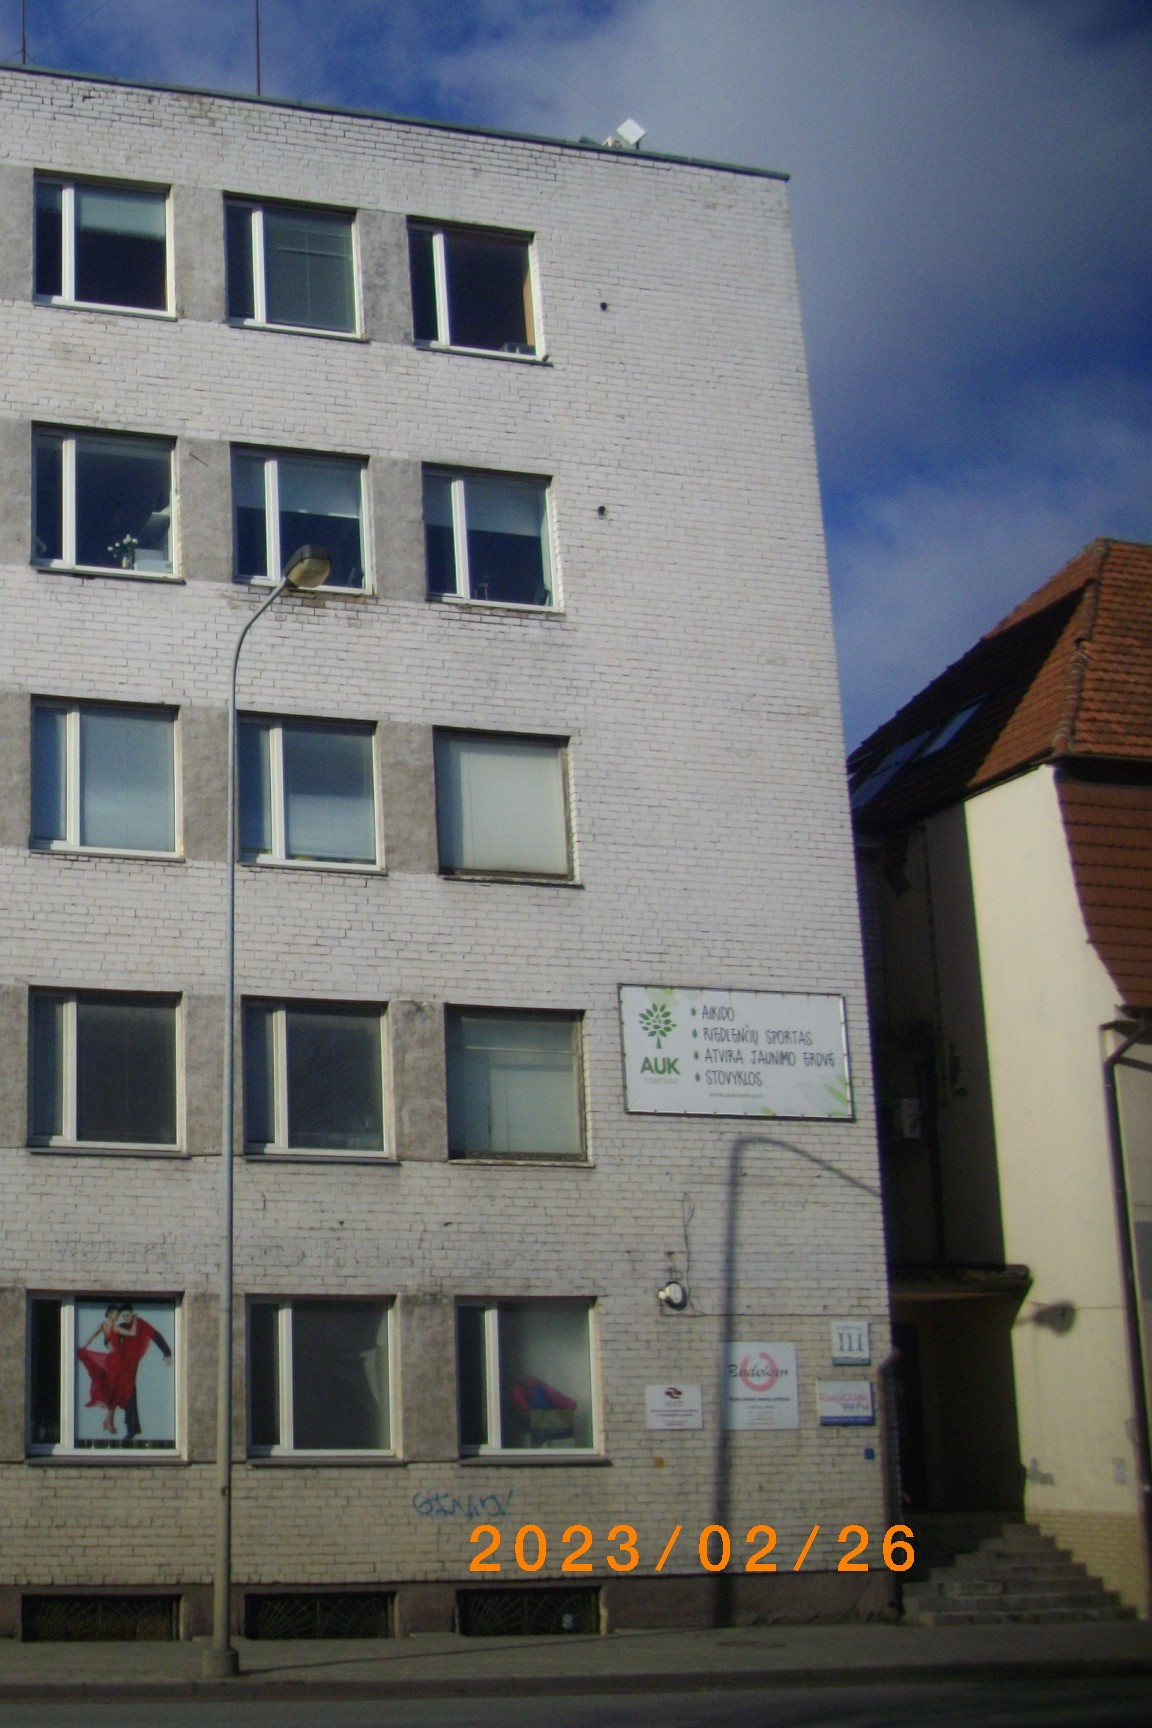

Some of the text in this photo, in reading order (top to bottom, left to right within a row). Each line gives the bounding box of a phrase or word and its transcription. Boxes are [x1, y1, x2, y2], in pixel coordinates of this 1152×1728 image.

[701, 1004, 735, 1022] AIKIDO
[765, 1029, 813, 1046] SPORTAS
[640, 1057, 681, 1075] AUK
[704, 1048, 744, 1065] ATVIRA
[751, 1050, 796, 1067] JAUNIMO
[705, 1069, 763, 1087] STOVYKLOS
